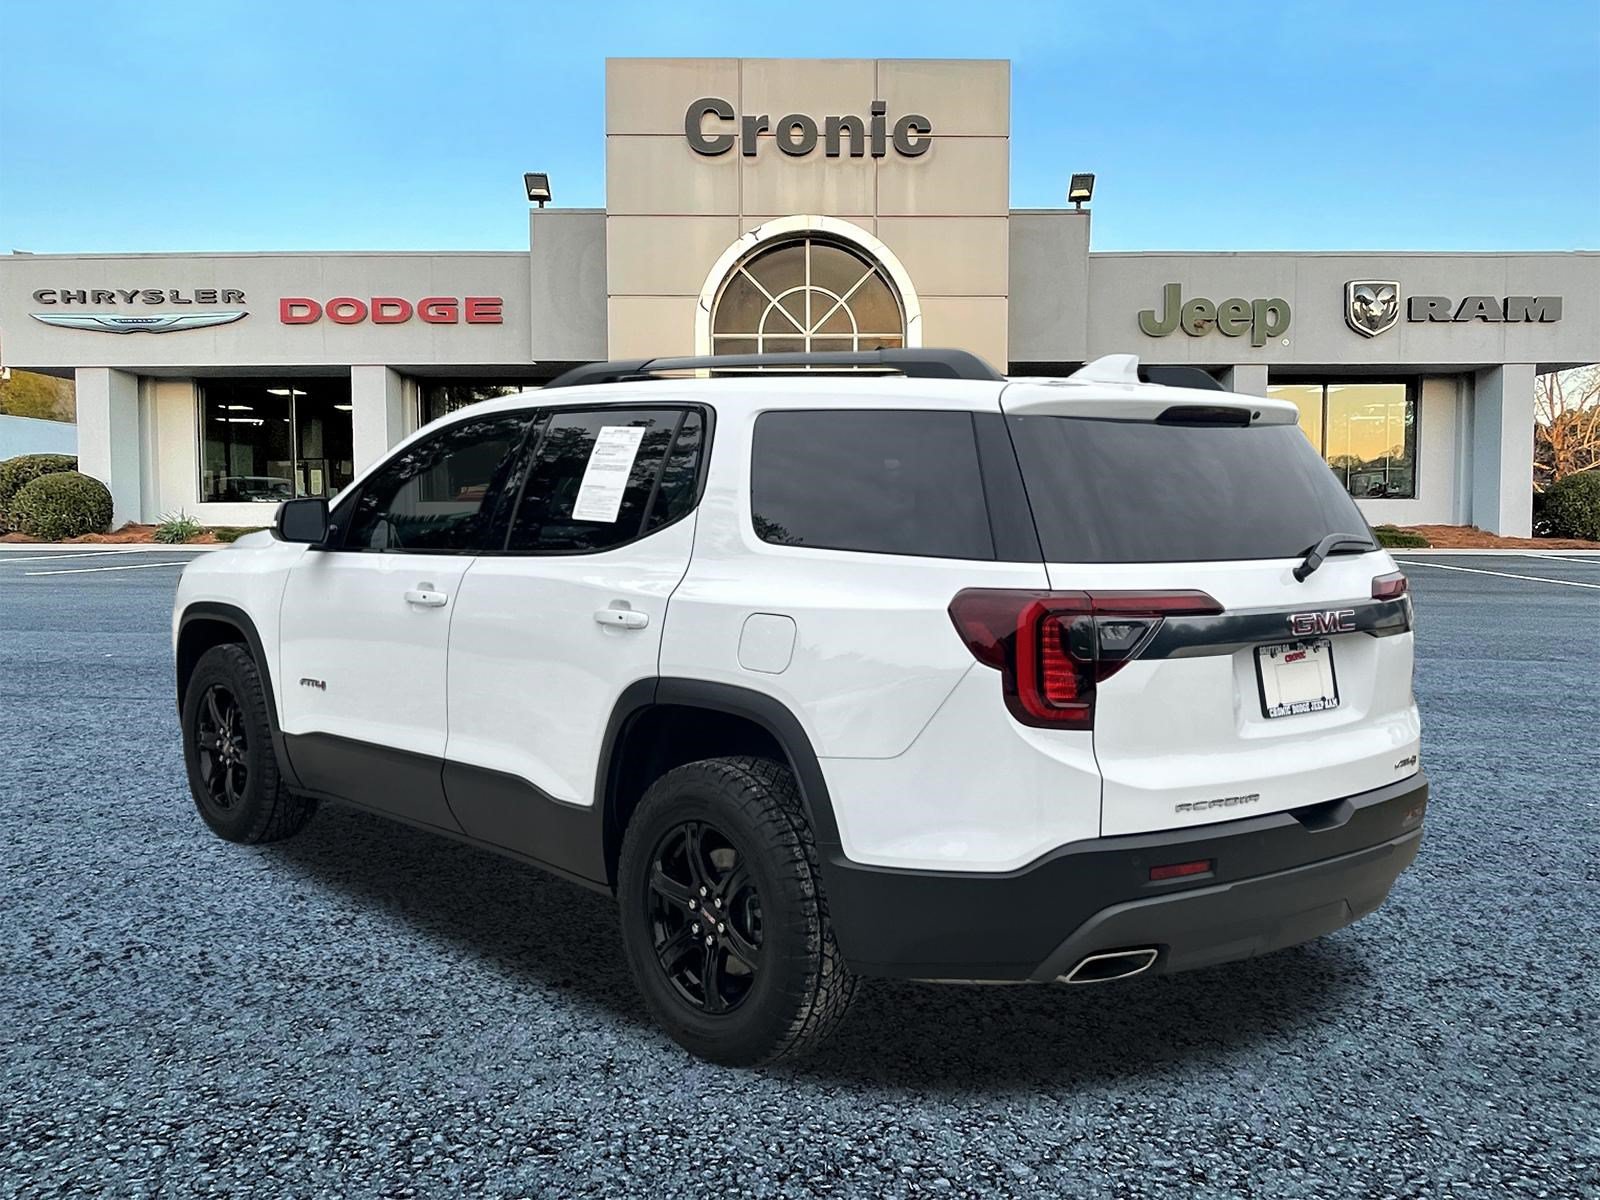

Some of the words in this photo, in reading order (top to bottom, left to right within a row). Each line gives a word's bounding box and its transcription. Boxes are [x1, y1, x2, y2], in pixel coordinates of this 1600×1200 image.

[684, 97, 932, 157] Cronic
[32, 289, 246, 305] CHRYSLER
[279, 297, 504, 325] DODGE
[1407, 295, 1563, 323] RAM
[1137, 283, 1292, 348] Jeep
[1290, 609, 1356, 637] GMC
